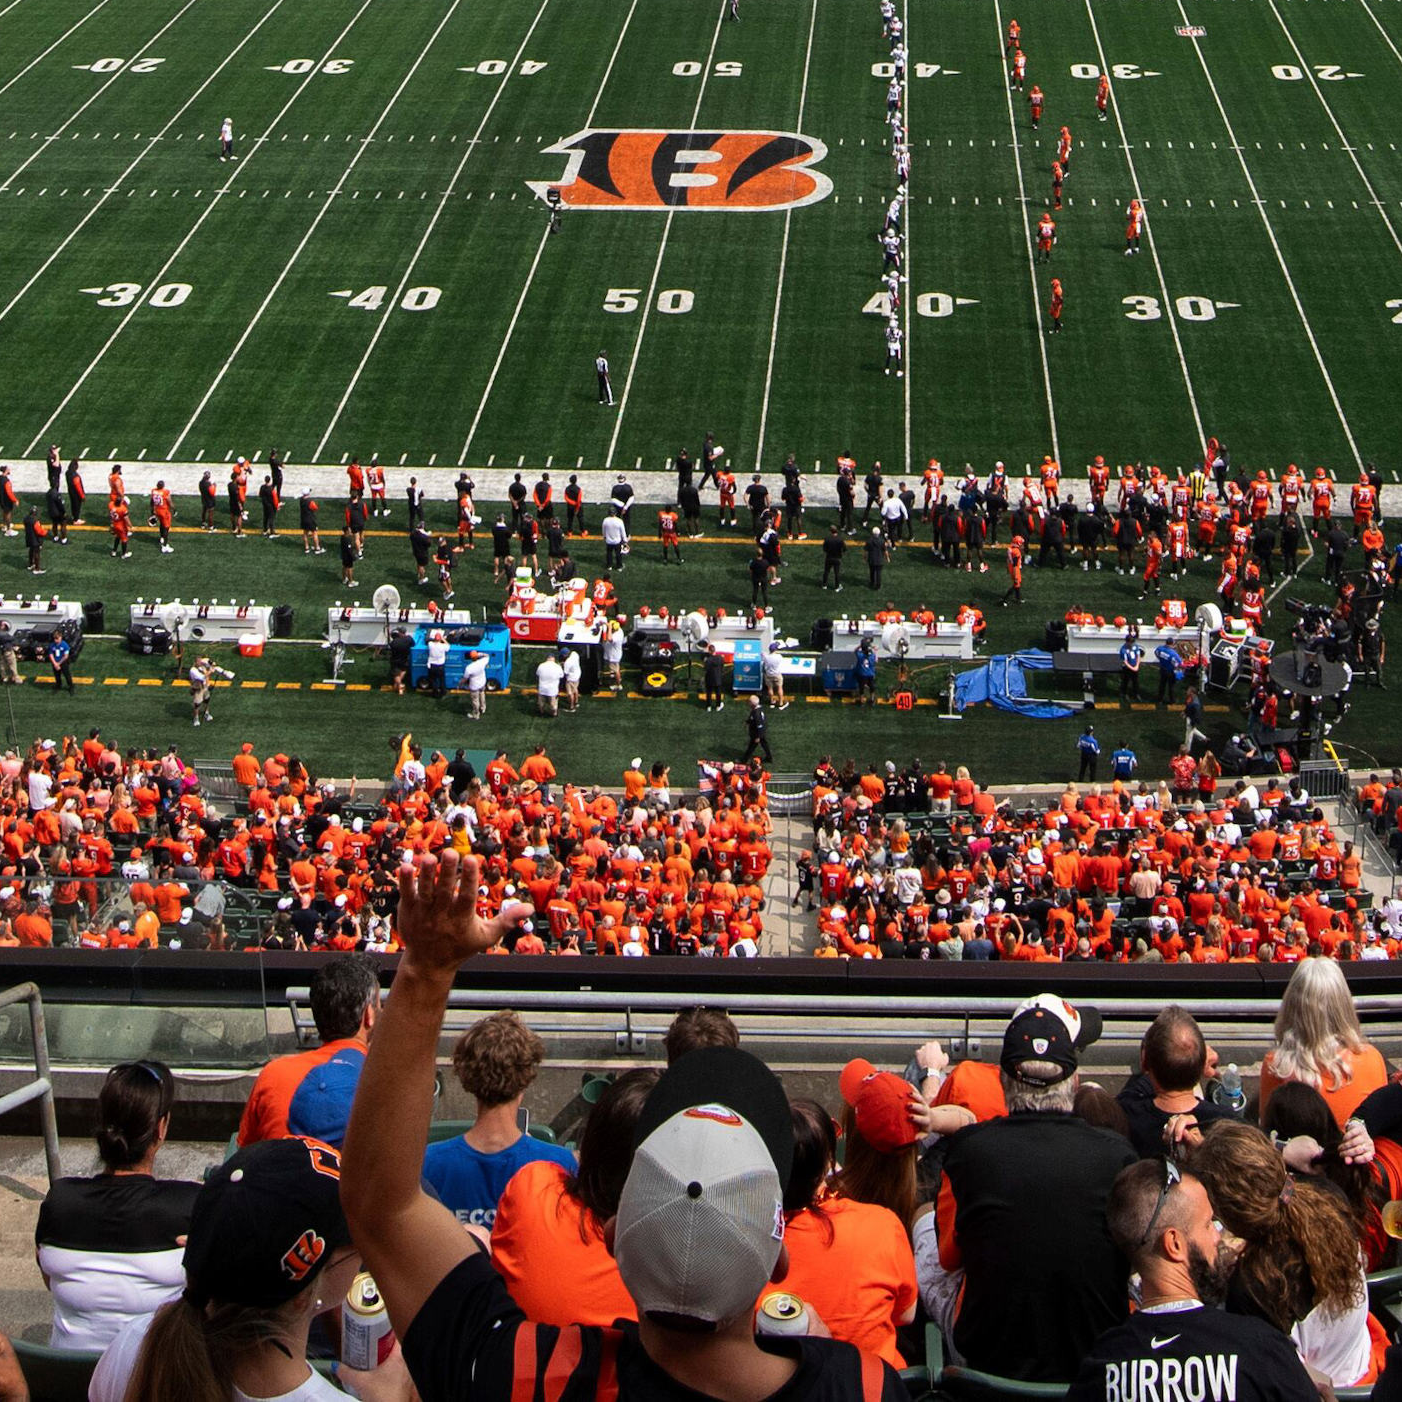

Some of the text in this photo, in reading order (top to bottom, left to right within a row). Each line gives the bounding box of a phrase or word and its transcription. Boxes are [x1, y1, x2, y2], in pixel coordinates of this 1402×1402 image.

[97, 282, 193, 308] 30
[348, 285, 443, 312] 40
[603, 288, 695, 314] 50
[1123, 295, 1216, 322] 30
[514, 619, 530, 636] G
[898, 695, 910, 709] 40
[1106, 1354, 1238, 1402] BURROW
